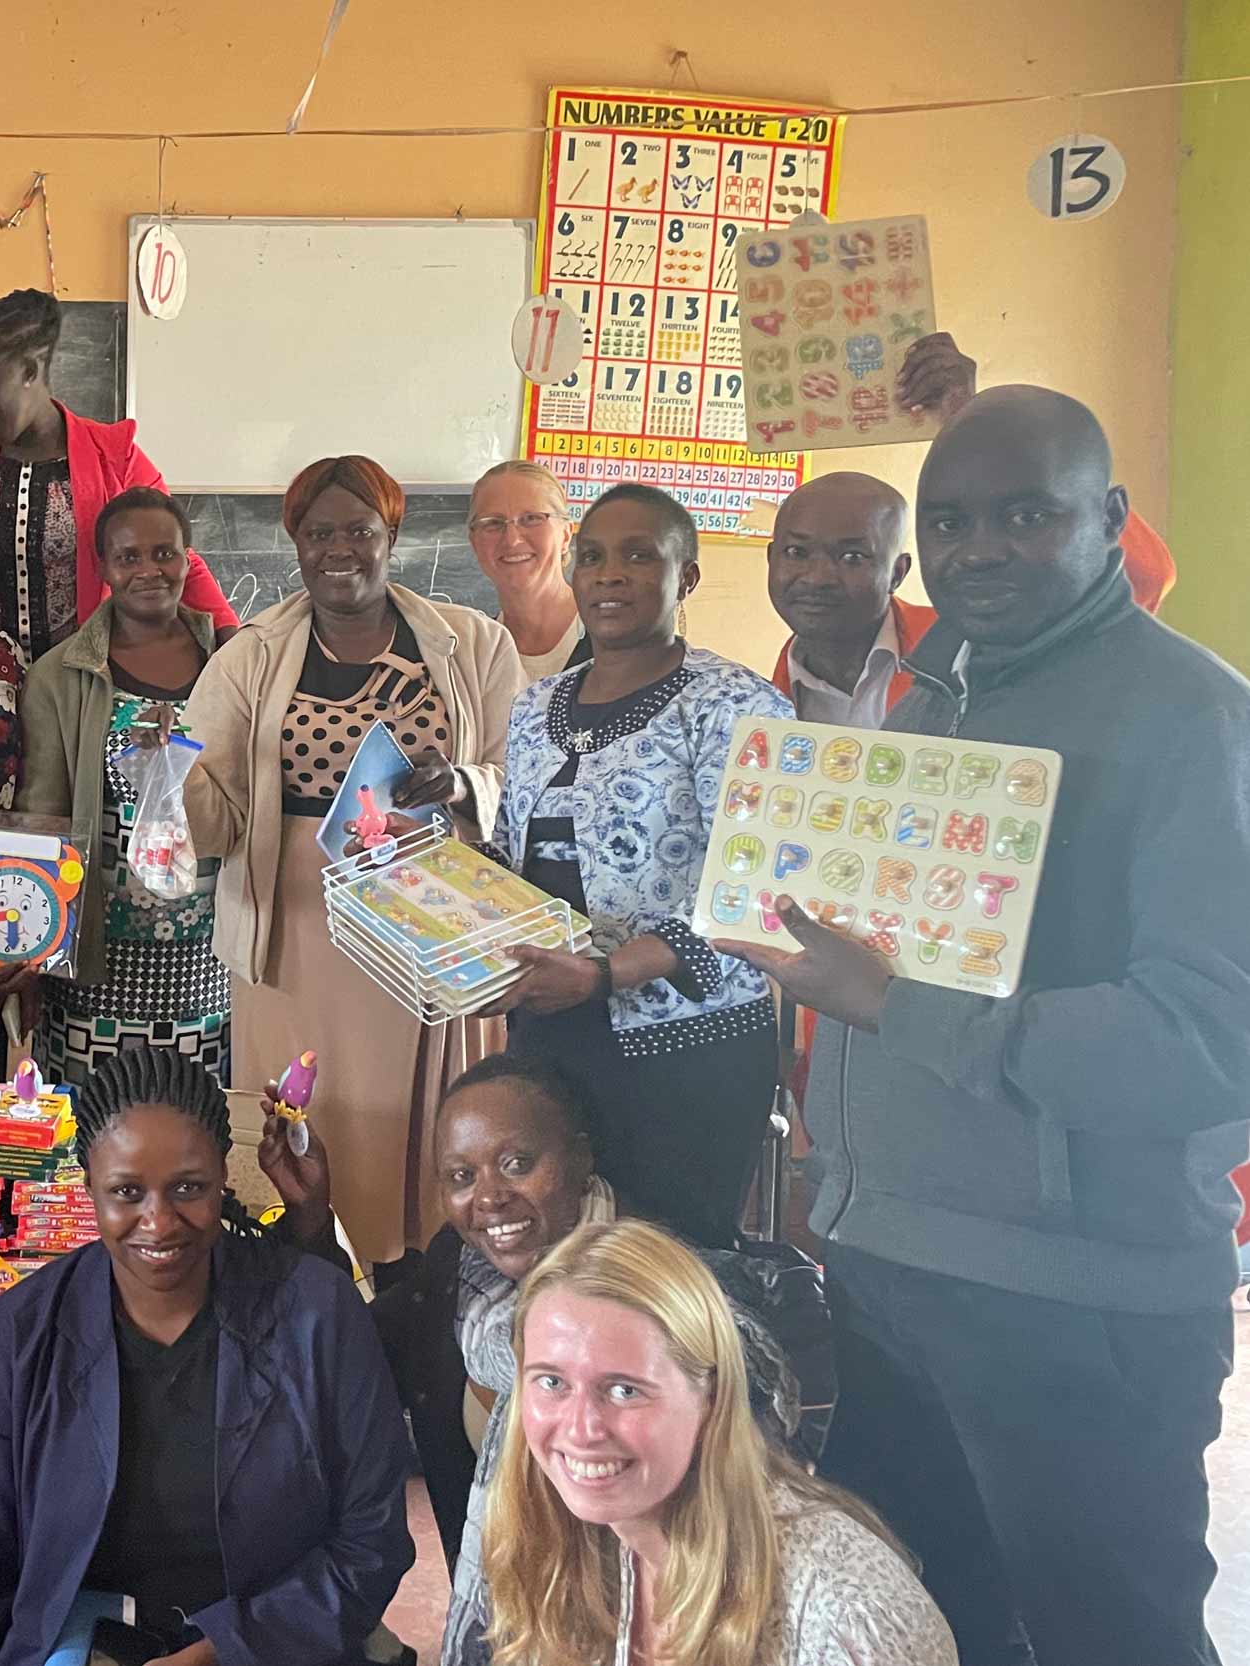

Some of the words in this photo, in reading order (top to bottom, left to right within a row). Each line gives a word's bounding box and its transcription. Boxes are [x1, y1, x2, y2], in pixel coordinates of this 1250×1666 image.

[564, 100, 685, 130] NUMBERS
[693, 108, 767, 138] VALUE
[777, 115, 829, 142] 1-20
[567, 137, 576, 161] 1
[584, 140, 602, 148] ONE
[621, 141, 638, 165] 2
[643, 144, 661, 152] TWO
[676, 144, 691, 169] 3
[693, 147, 716, 156] THREE
[726, 150, 743, 173] 4
[746, 153, 768, 161] FOUR
[780, 154, 797, 178] 5
[803, 157, 819, 165] FVE
[1050, 146, 1110, 217] 13
[558, 211, 575, 236] 6
[613, 215, 631, 239] 7
[631, 218, 657, 226] SEVEN
[667, 218, 684, 243] 8
[687, 221, 710, 230] EIGHT
[721, 223, 738, 247] 9
[151, 242, 176, 304] 10
[611, 292, 646, 317] 12
[665, 295, 700, 320] 13
[611, 319, 641, 328] TWELVE
[661, 322, 698, 331] THIRTEEN
[605, 366, 641, 391] 17
[657, 370, 692, 395] 18
[713, 373, 742, 399] 19
[548, 390, 581, 399] SIXTEEN
[596, 393, 642, 403] SEVENTEEN
[653, 396, 691, 406] EIGHTEEN
[706, 400, 744, 409] NINETEEN
[542, 436, 546, 449] 1
[559, 438, 565, 450] 2
[576, 439, 583, 451] 3
[594, 440, 601, 452] 4
[611, 441, 619, 453] 5
[630, 443, 637, 454] 6
[648, 444, 655, 455] 7
[665, 445, 672, 456] 8
[683, 446, 690, 457] 9
[698, 447, 711, 459] 10
[716, 448, 727, 460] 11
[733, 449, 745, 461] 12
[784, 452, 796, 464] 15
[554, 461, 567, 473] 17
[572, 462, 585, 474] 18
[591, 463, 603, 475] 19
[606, 464, 620, 476] 20
[624, 465, 637, 477] 21
[642, 466, 656, 478] 22
[660, 467, 673, 479] 23
[678, 468, 691, 480] 24
[695, 469, 709, 481] 25
[712, 471, 726, 483] 26
[730, 472, 743, 484] 27
[747, 473, 760, 485] 28
[764, 474, 777, 486] 29
[781, 475, 794, 487] 30
[569, 484, 583, 497] 33
[676, 490, 690, 503] 39
[693, 492, 707, 504] 40
[710, 493, 722, 506] 41
[727, 494, 741, 507] 42
[708, 515, 721, 528] 56
[725, 516, 739, 529] 57
[736, 728, 769, 770] A
[780, 734, 815, 775] B
[821, 737, 861, 782] C
[865, 744, 904, 787] D
[852, 796, 890, 841] K
[896, 805, 933, 849] L
[943, 811, 988, 855] M
[12, 876, 23, 886] 12
[32, 884, 36, 892] 1
[773, 840, 812, 881] P
[874, 856, 915, 903] R
[925, 864, 966, 909] S
[977, 872, 1018, 917] T
[42, 899, 48, 907] 2
[43, 917, 50, 925] 3
[713, 882, 748, 924] U
[867, 911, 903, 956] X
[915, 918, 953, 963] Y
[959, 929, 1006, 976] Z
[4, 945, 10, 953] 6
[21, 943, 27, 952] 5
[36, 934, 42, 942] 4
